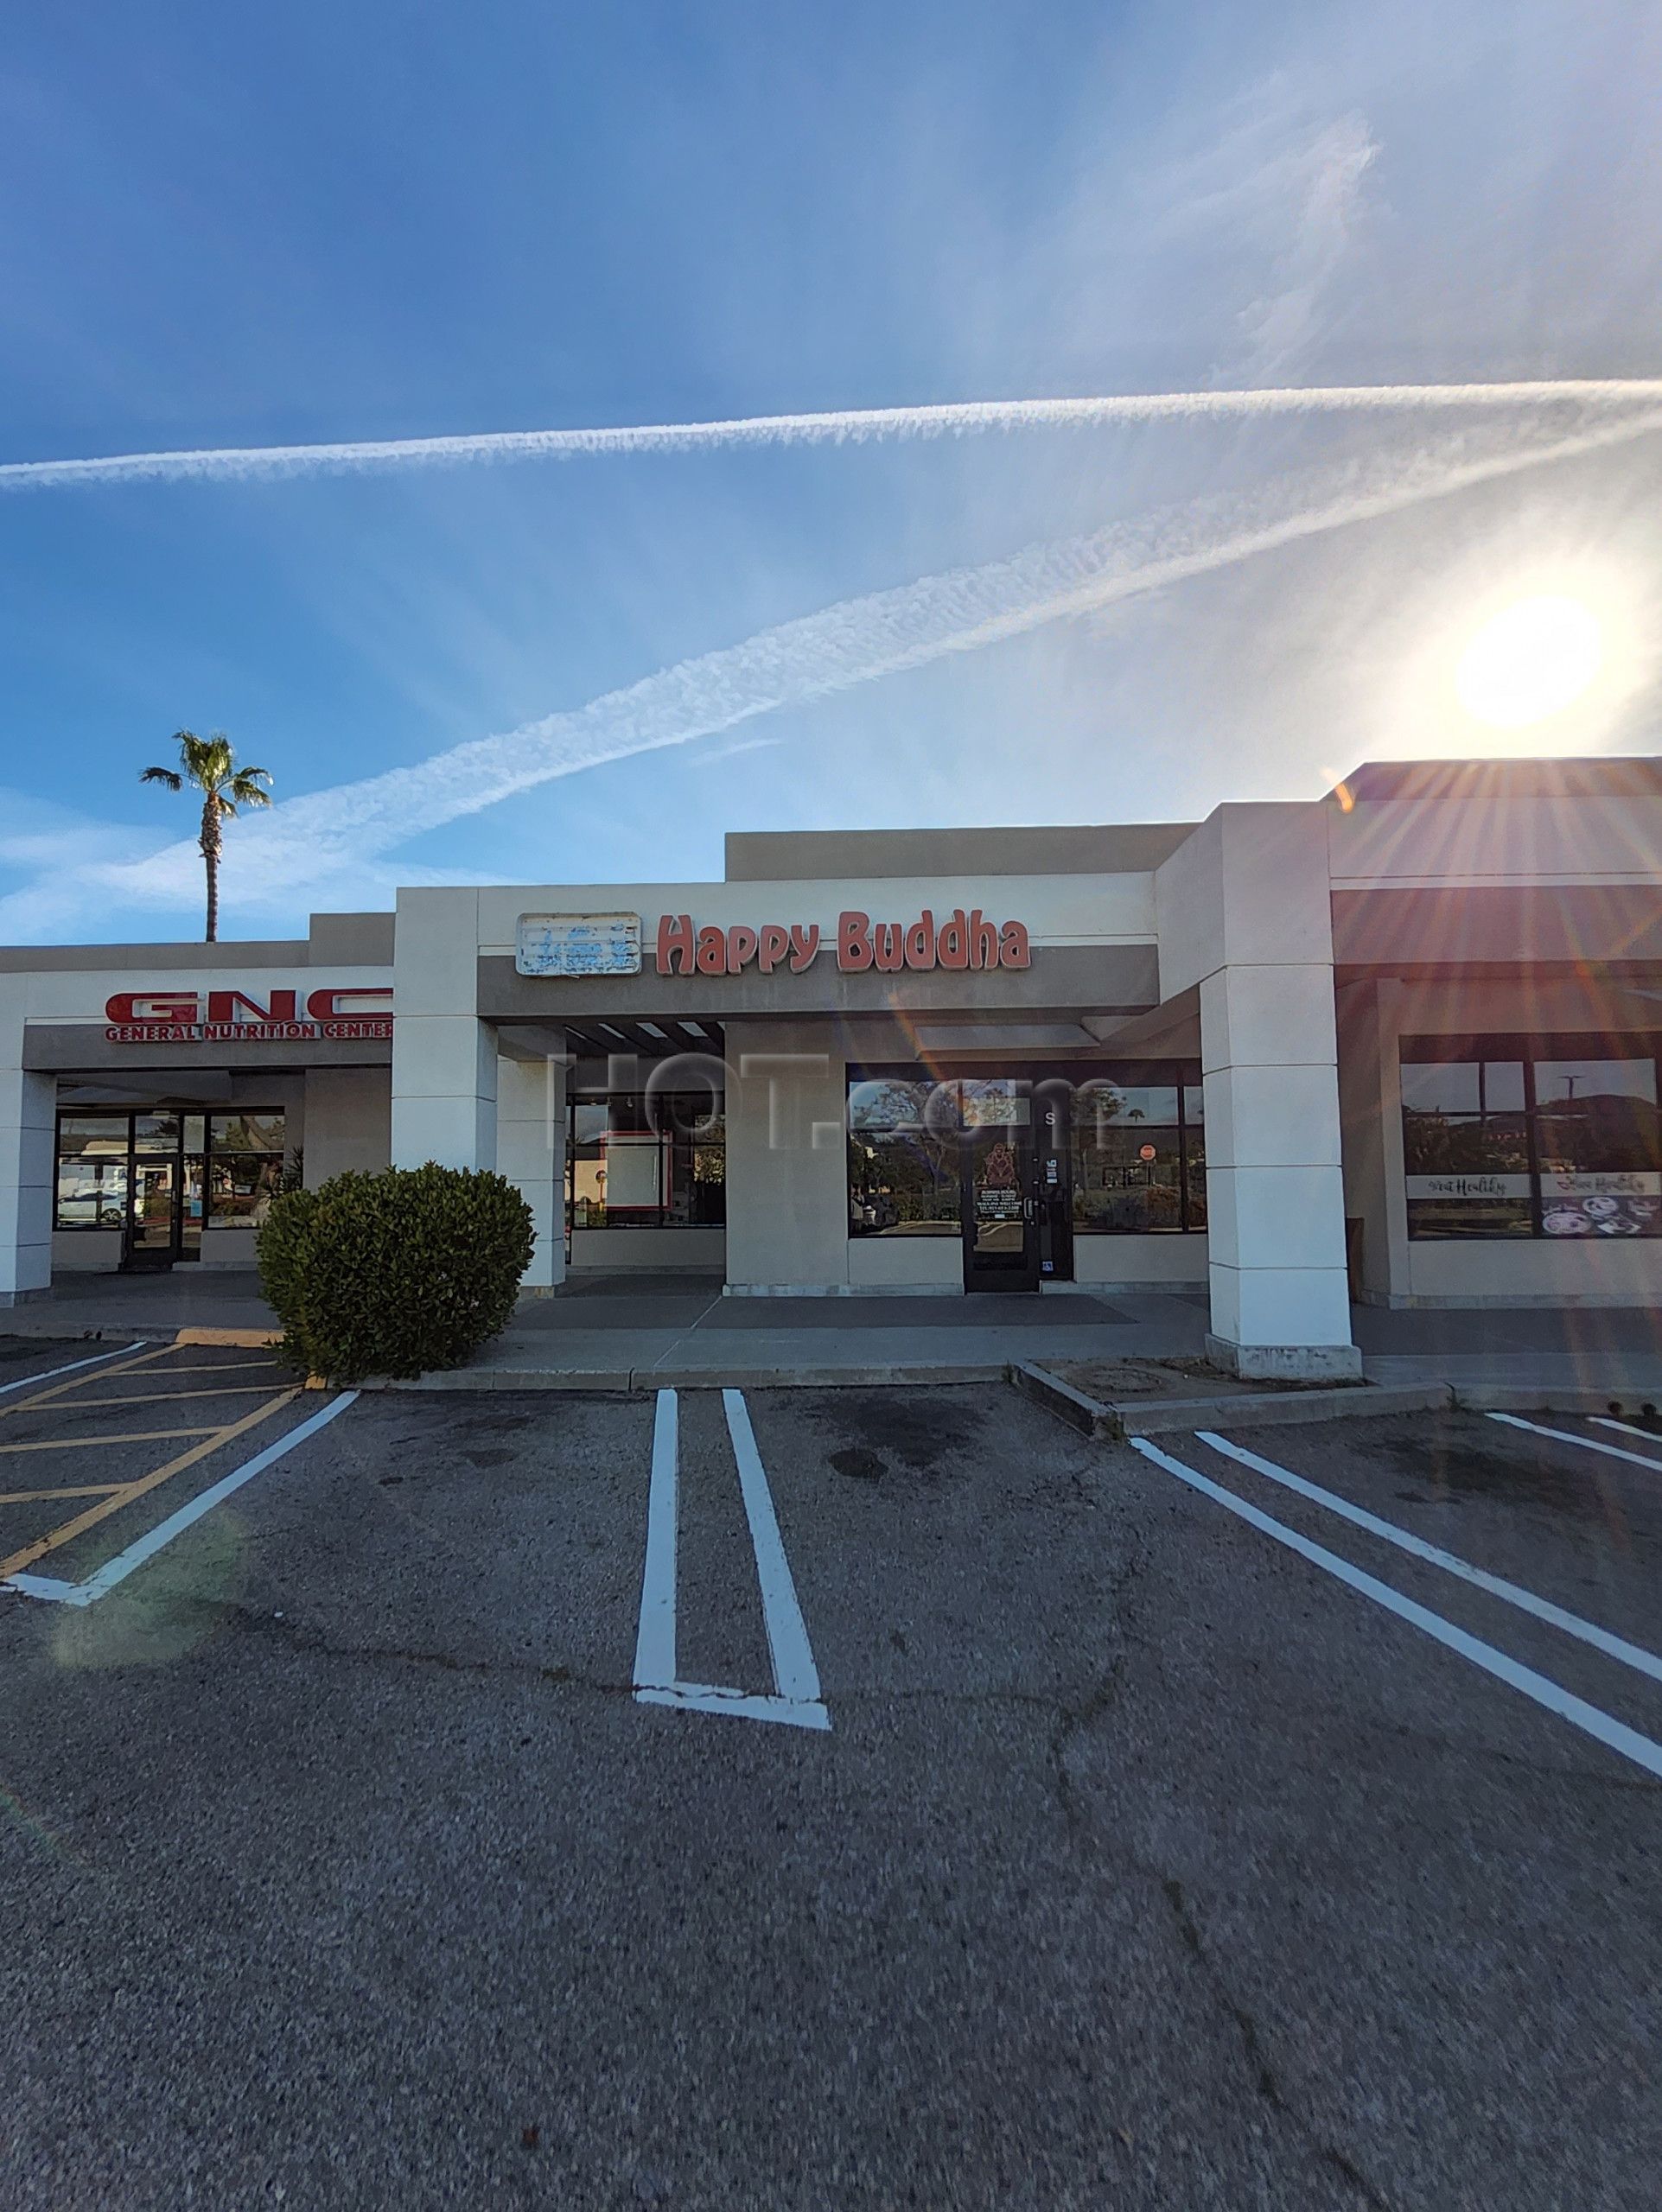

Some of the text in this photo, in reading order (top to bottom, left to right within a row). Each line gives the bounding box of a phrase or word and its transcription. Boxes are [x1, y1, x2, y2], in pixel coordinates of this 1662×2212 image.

[657, 909, 1033, 976] Happy Buddha
[105, 988, 394, 1024] GNC
[105, 1025, 198, 1042] GENERAL
[204, 1021, 317, 1040] NUTRITION
